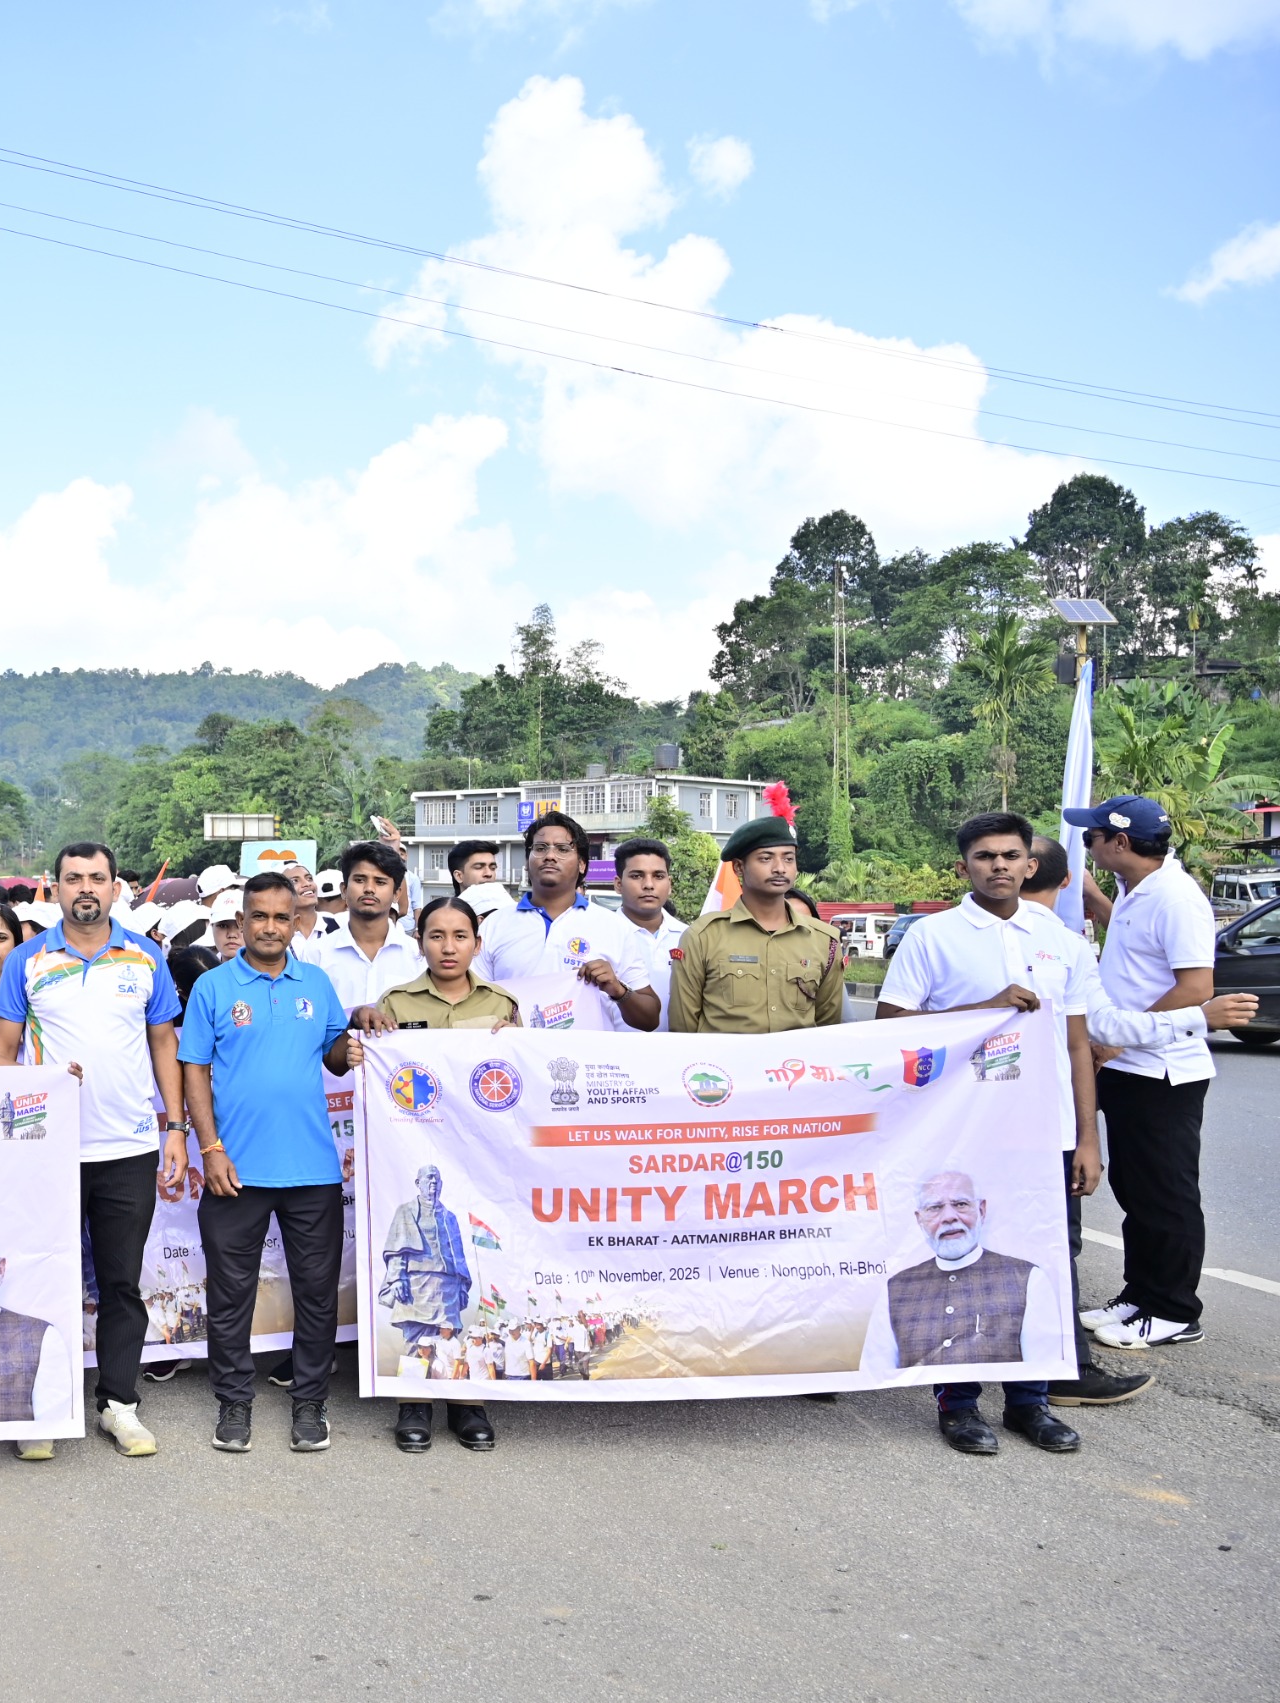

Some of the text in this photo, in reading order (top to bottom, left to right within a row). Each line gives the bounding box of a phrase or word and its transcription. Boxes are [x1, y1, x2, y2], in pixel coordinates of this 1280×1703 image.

[545, 1002, 570, 1017] UNITY
[546, 1011, 573, 1026] MARCH
[986, 1035, 1018, 1049] UNITY
[987, 1043, 1019, 1057] MARCH
[399, 1061, 423, 1069] SCIENCE
[917, 1064, 931, 1072] NCC
[586, 1079, 635, 1088] MINISTRY OF
[587, 1087, 660, 1096] YOUTH AFFAIRS
[16, 1094, 45, 1108] UNITY
[587, 1095, 646, 1105] AND SPORTS
[16, 1104, 46, 1117] MARCH
[568, 1121, 841, 1142] LET US WALK FOR UNITY, RISE FOR NATION
[628, 1149, 784, 1174] SARDAR@150
[531, 1172, 879, 1223] UNITY MARCH
[588, 1226, 832, 1247] EK BHARAT AATMANIRBHAR BHARAT
[163, 1247, 189, 1260] Date
[534, 1260, 887, 1285] Date 10th November, 2025 Venue Nongpoh, Ri-Bhoi
